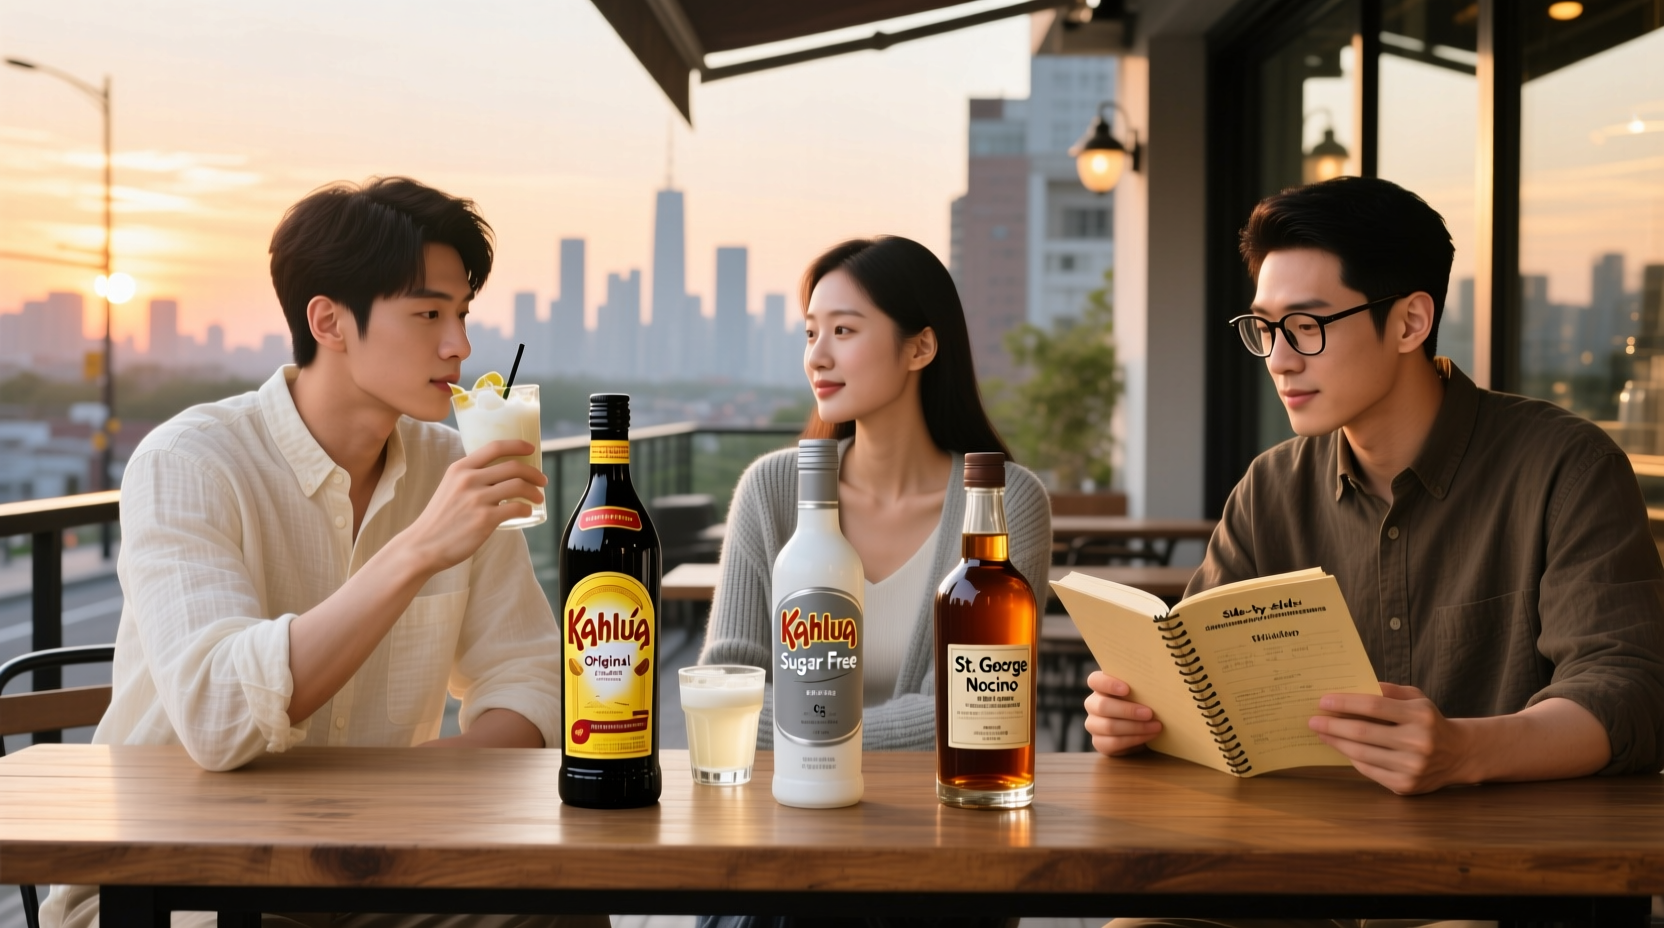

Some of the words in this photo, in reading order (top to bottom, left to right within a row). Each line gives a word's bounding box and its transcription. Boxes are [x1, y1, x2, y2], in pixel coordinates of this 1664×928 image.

[568, 606, 650, 651] Kahlúa
[584, 654, 631, 669] Original
[780, 652, 823, 676] Sugar
[827, 651, 857, 670] Free
[955, 655, 976, 673] St.
[966, 676, 1018, 692] Nocino
